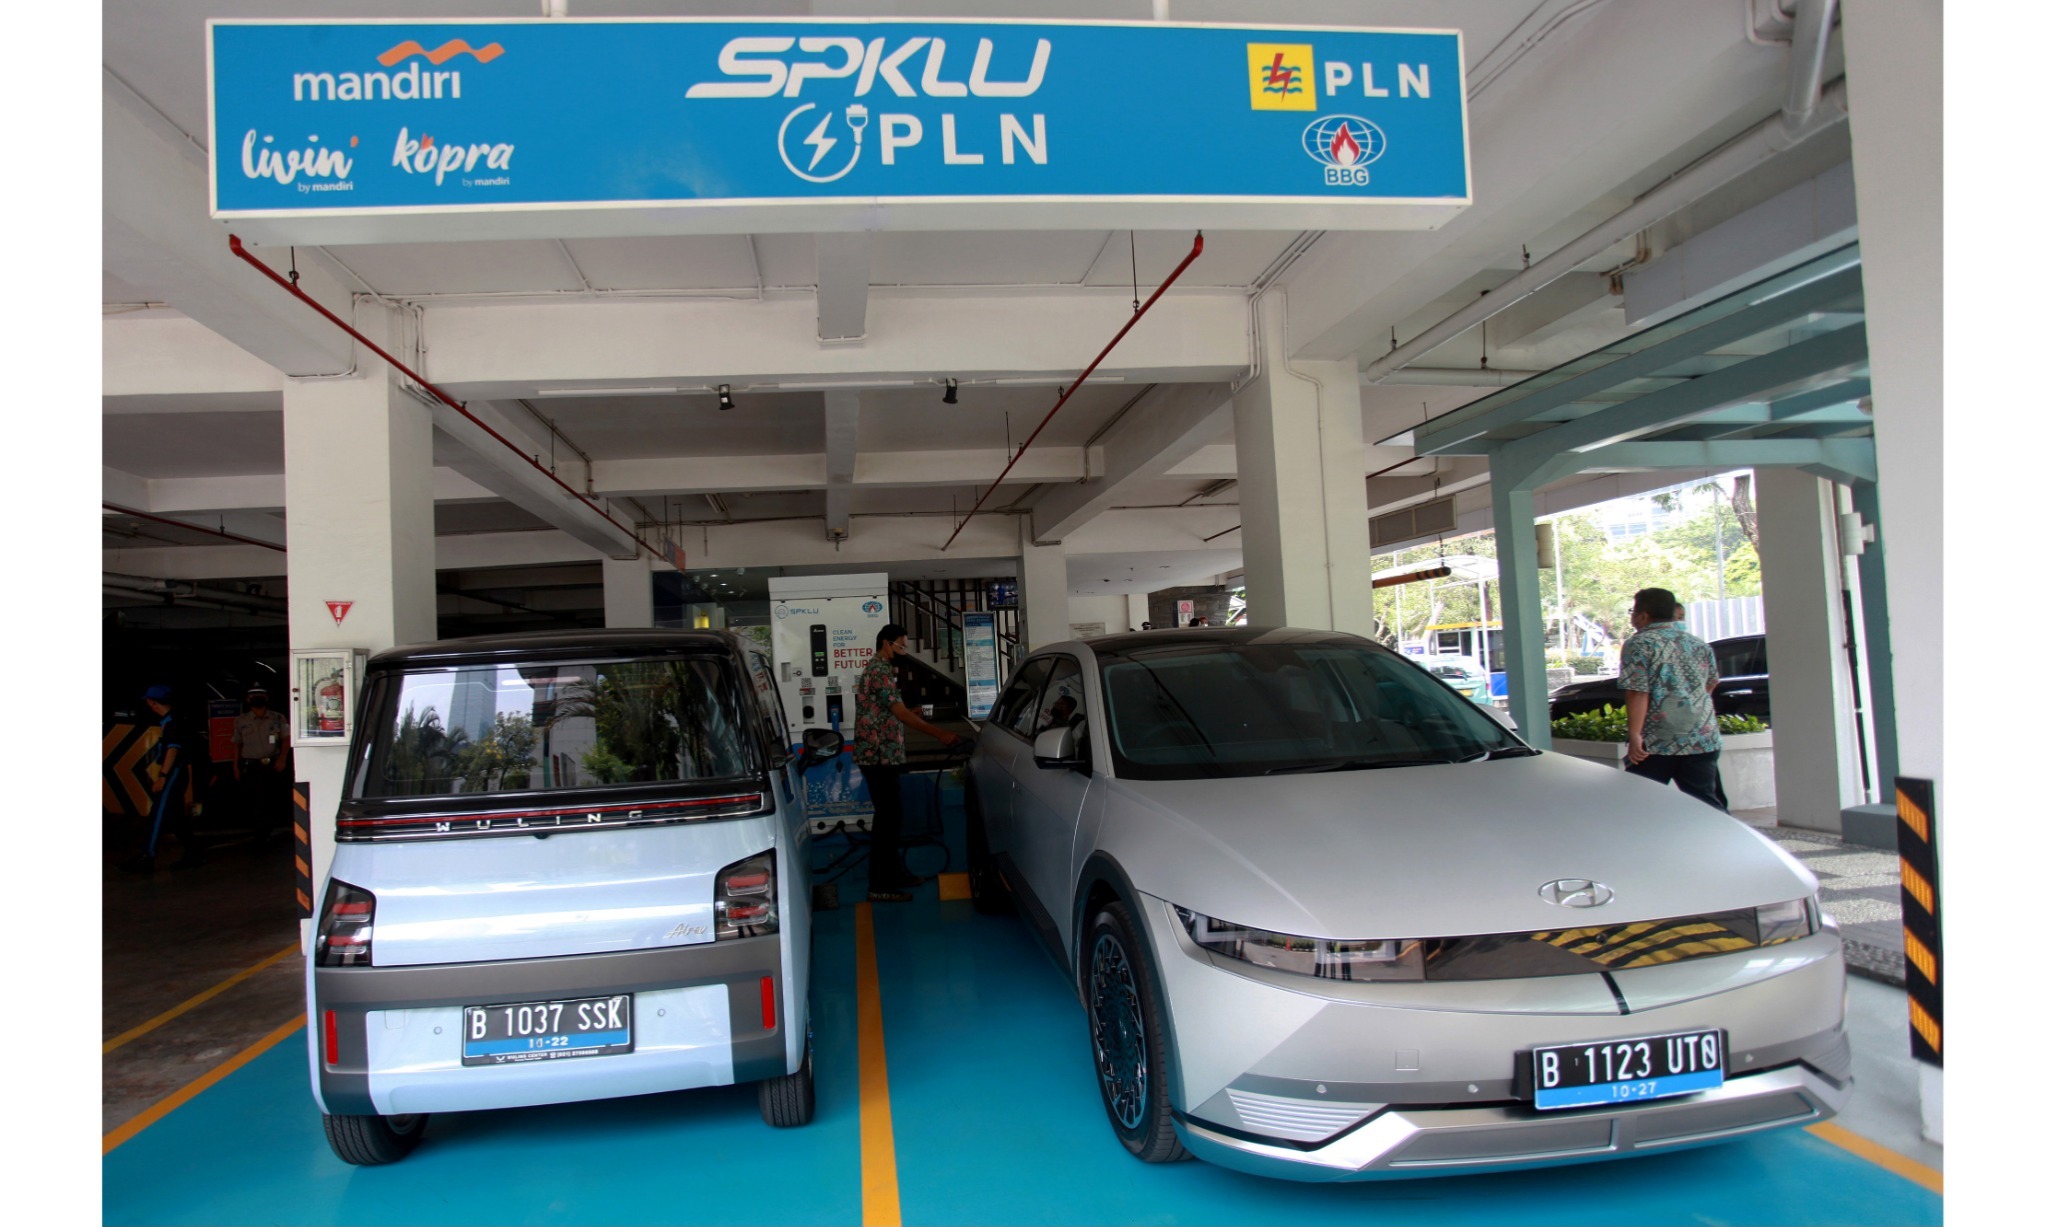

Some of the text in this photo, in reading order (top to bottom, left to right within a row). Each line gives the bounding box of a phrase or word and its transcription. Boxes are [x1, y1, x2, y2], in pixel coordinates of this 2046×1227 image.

[294, 62, 461, 101] mandiri
[685, 37, 1051, 98] SPKLU
[1324, 61, 1430, 98] PLN
[392, 127, 515, 186] kopra
[879, 113, 1048, 165] PLN
[297, 181, 354, 194] by mandiri
[462, 177, 510, 187] by mandiri
[1325, 167, 1369, 185] BBG
[834, 648, 873, 658] BETTER
[834, 659, 870, 669] FUTUR
[436, 810, 643, 832] WULING
[471, 998, 622, 1039] B 1037 SSK
[1541, 1052, 1560, 1088] B
[1584, 1042, 1651, 1083] 1123
